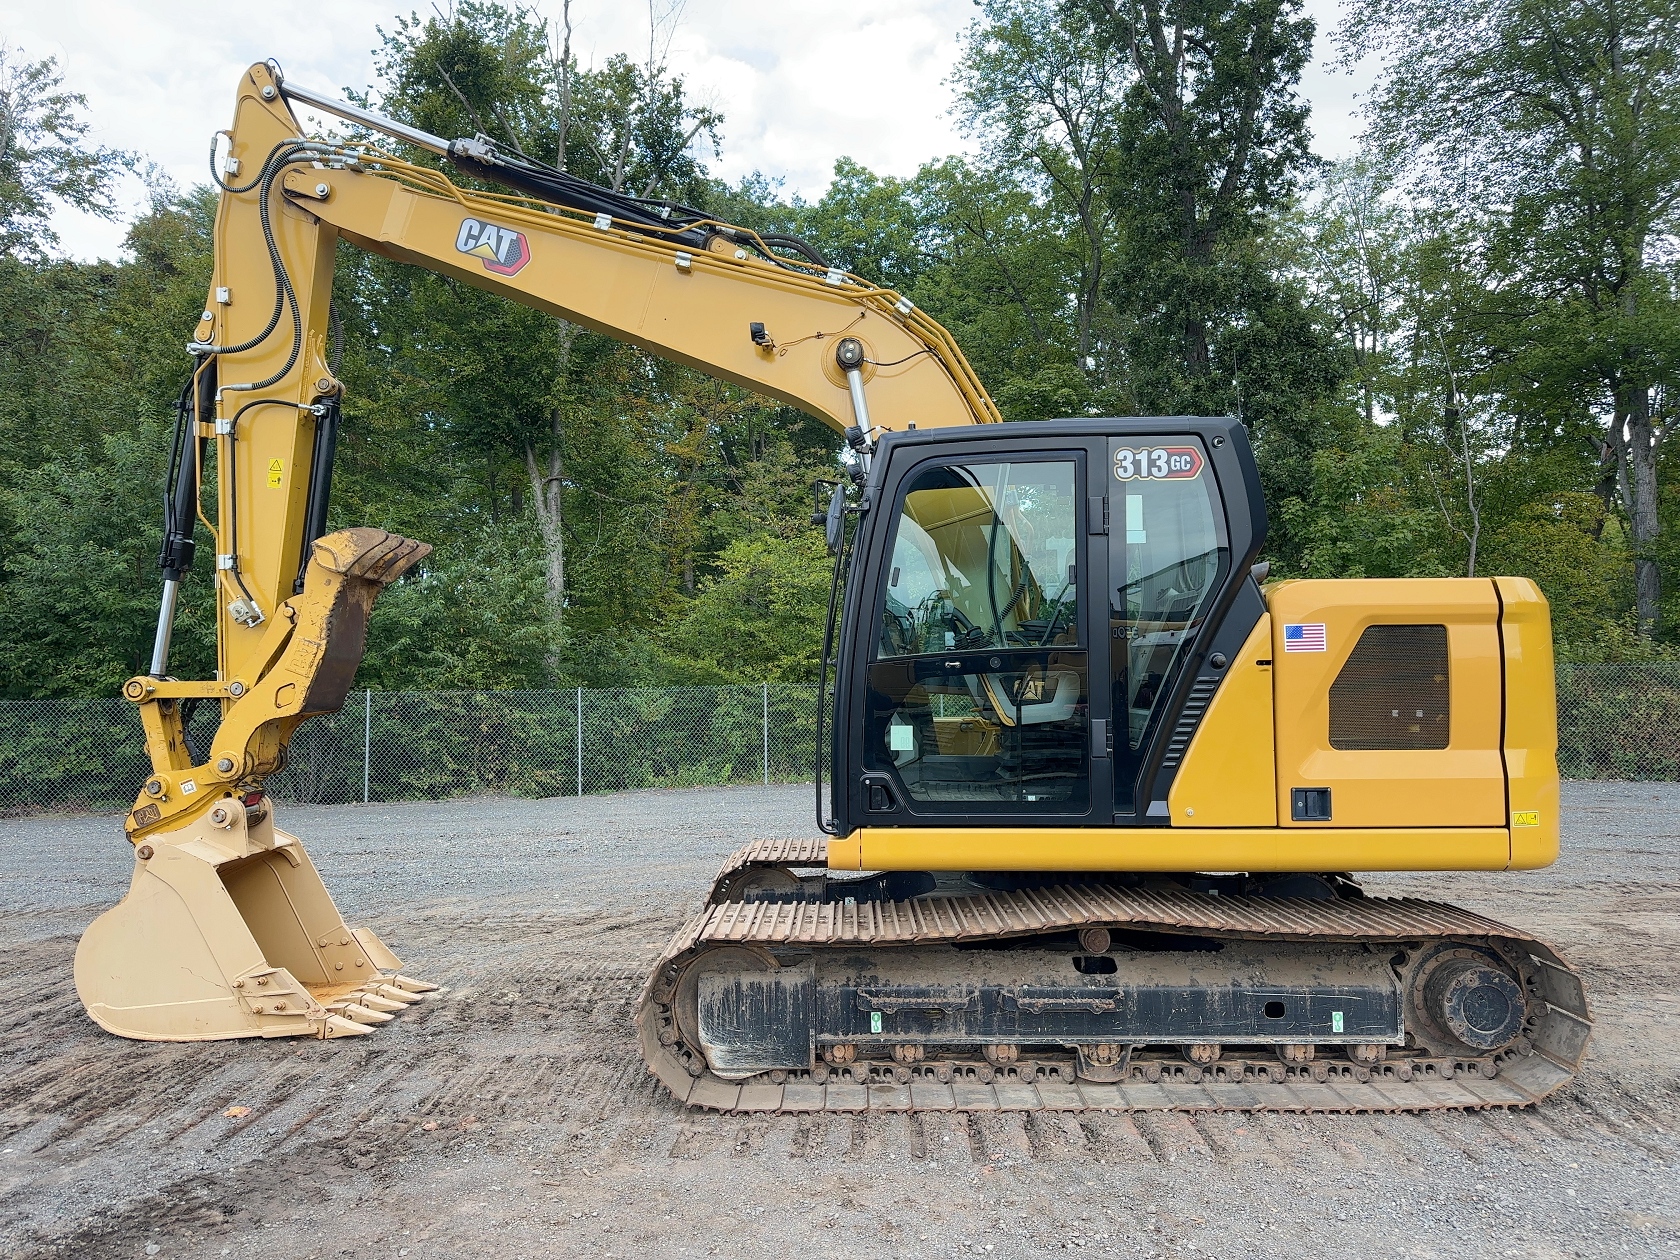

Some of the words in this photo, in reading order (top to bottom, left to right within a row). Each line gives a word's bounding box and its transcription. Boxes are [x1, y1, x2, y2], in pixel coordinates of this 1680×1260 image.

[456, 218, 518, 264] CAT
[1116, 449, 1169, 478] 313
[1170, 455, 1191, 471] GC
